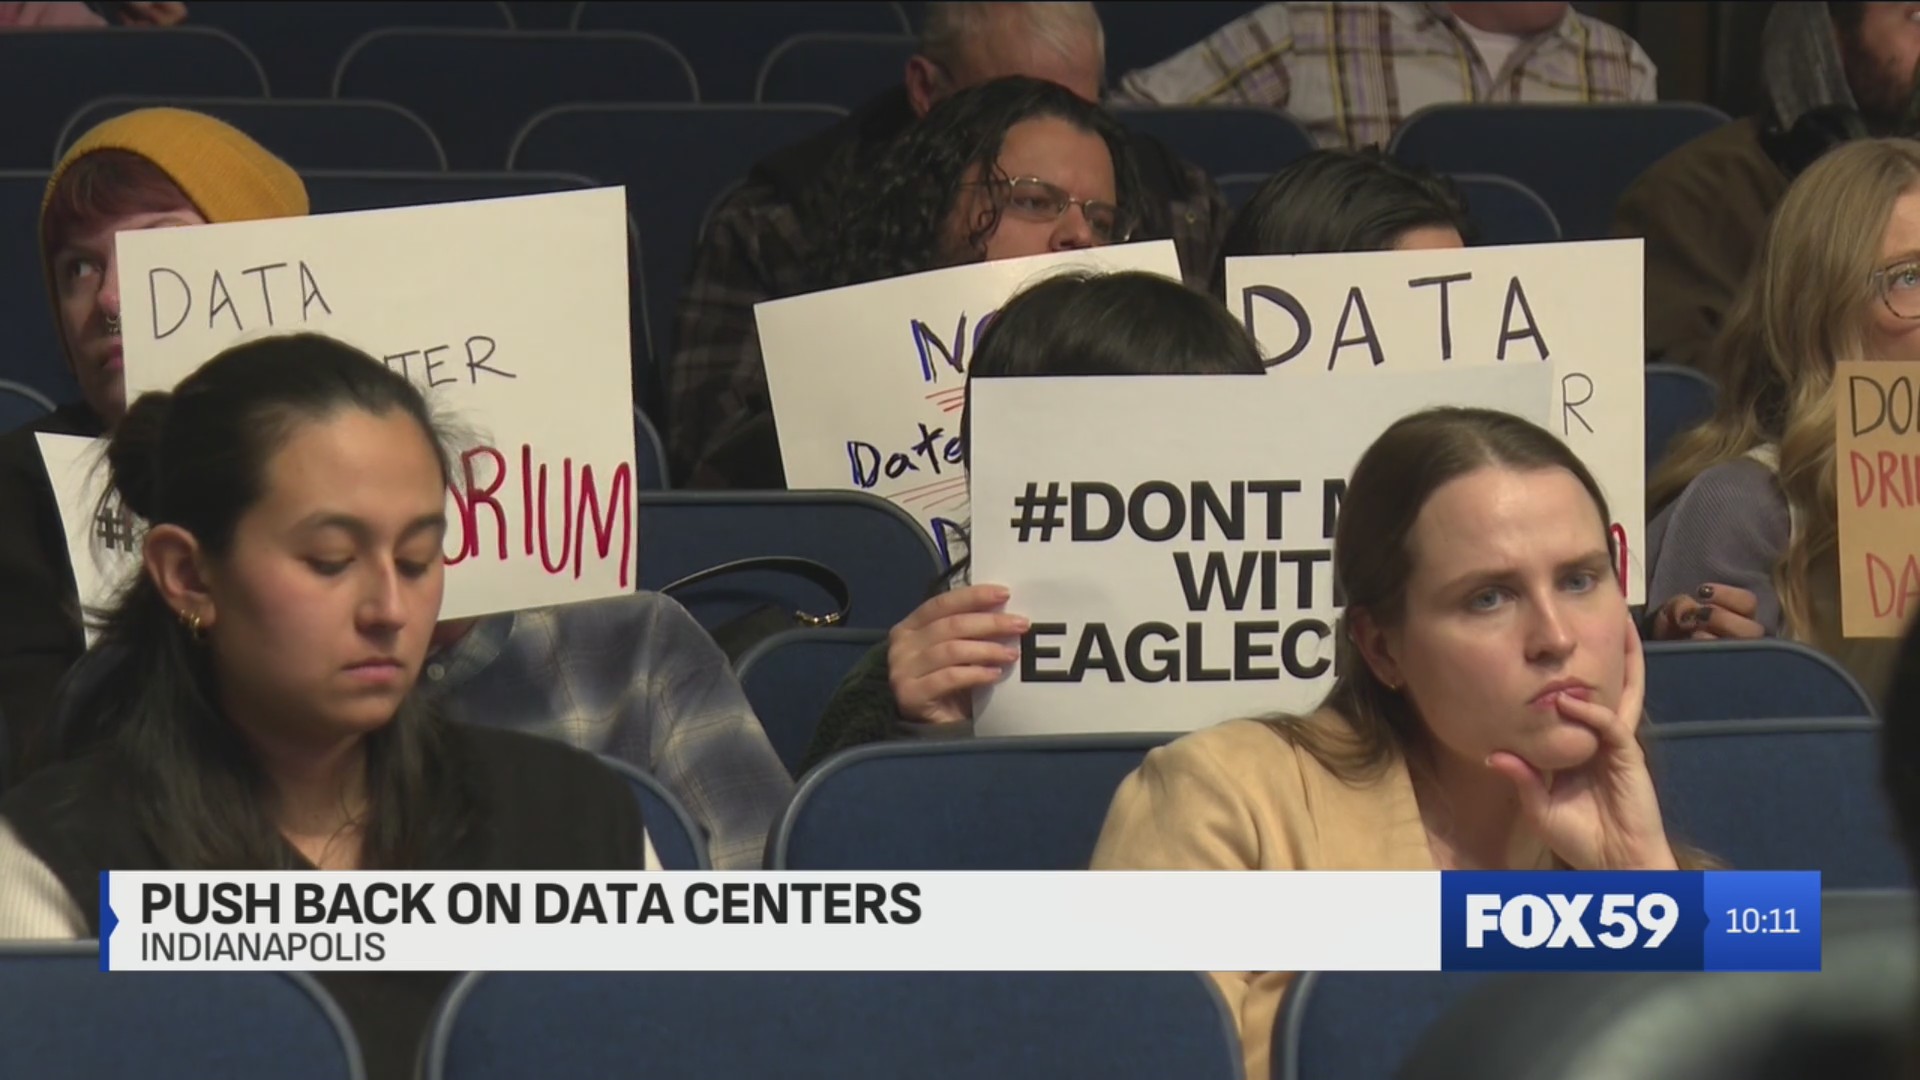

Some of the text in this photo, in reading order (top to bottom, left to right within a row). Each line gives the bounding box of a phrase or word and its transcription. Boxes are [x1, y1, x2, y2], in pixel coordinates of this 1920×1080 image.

[149, 261, 332, 339] DATA
[1242, 272, 1550, 371] DATA
[384, 336, 517, 388] TER
[1849, 376, 1920, 437] DO
[1010, 480, 1301, 542] #DONT
[1020, 618, 1340, 682] EAGLEC
